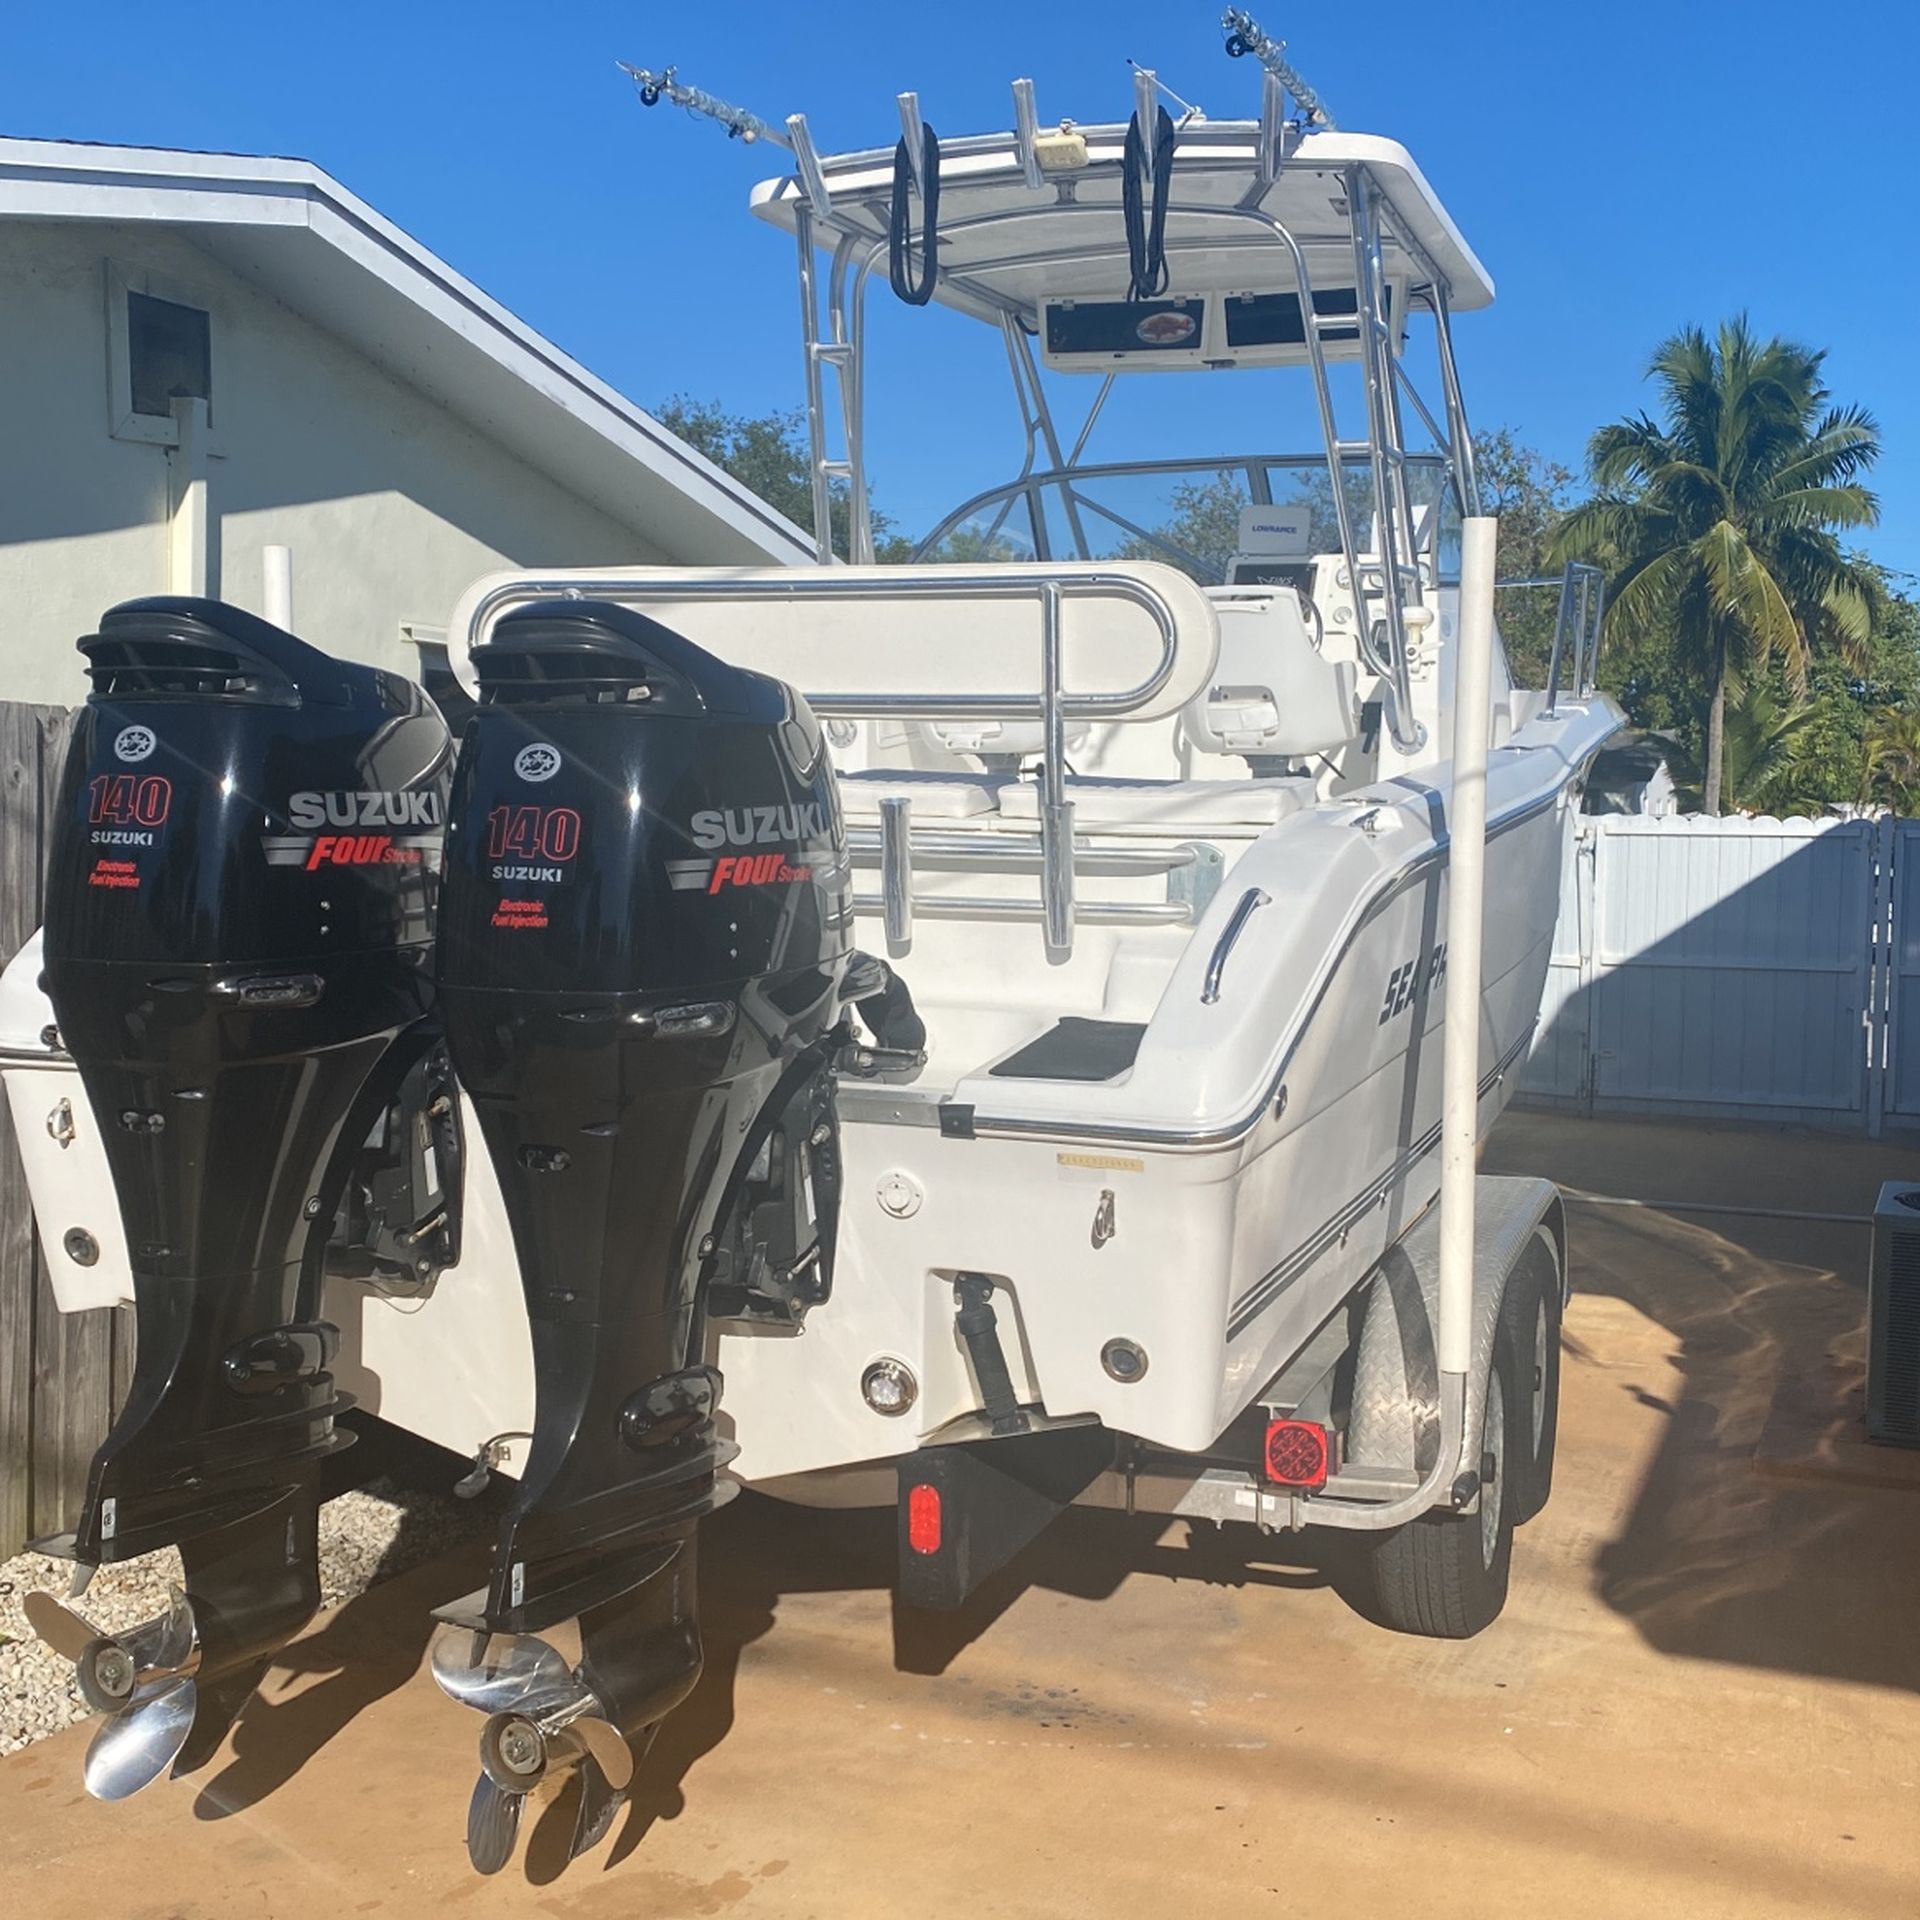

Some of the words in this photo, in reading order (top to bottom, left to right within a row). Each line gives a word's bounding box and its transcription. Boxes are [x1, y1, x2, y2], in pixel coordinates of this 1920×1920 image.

[1252, 525, 1297, 534] LOWRANCE
[88, 775, 172, 826] 140
[289, 791, 441, 829] SUZUKI
[90, 830, 153, 846] SUZUKI
[488, 806, 581, 862] 140
[691, 802, 825, 849] SUZUKI
[492, 866, 562, 882] SUZUKI
[1379, 952, 1424, 1026] SEA
[1424, 941, 1447, 996] PR
